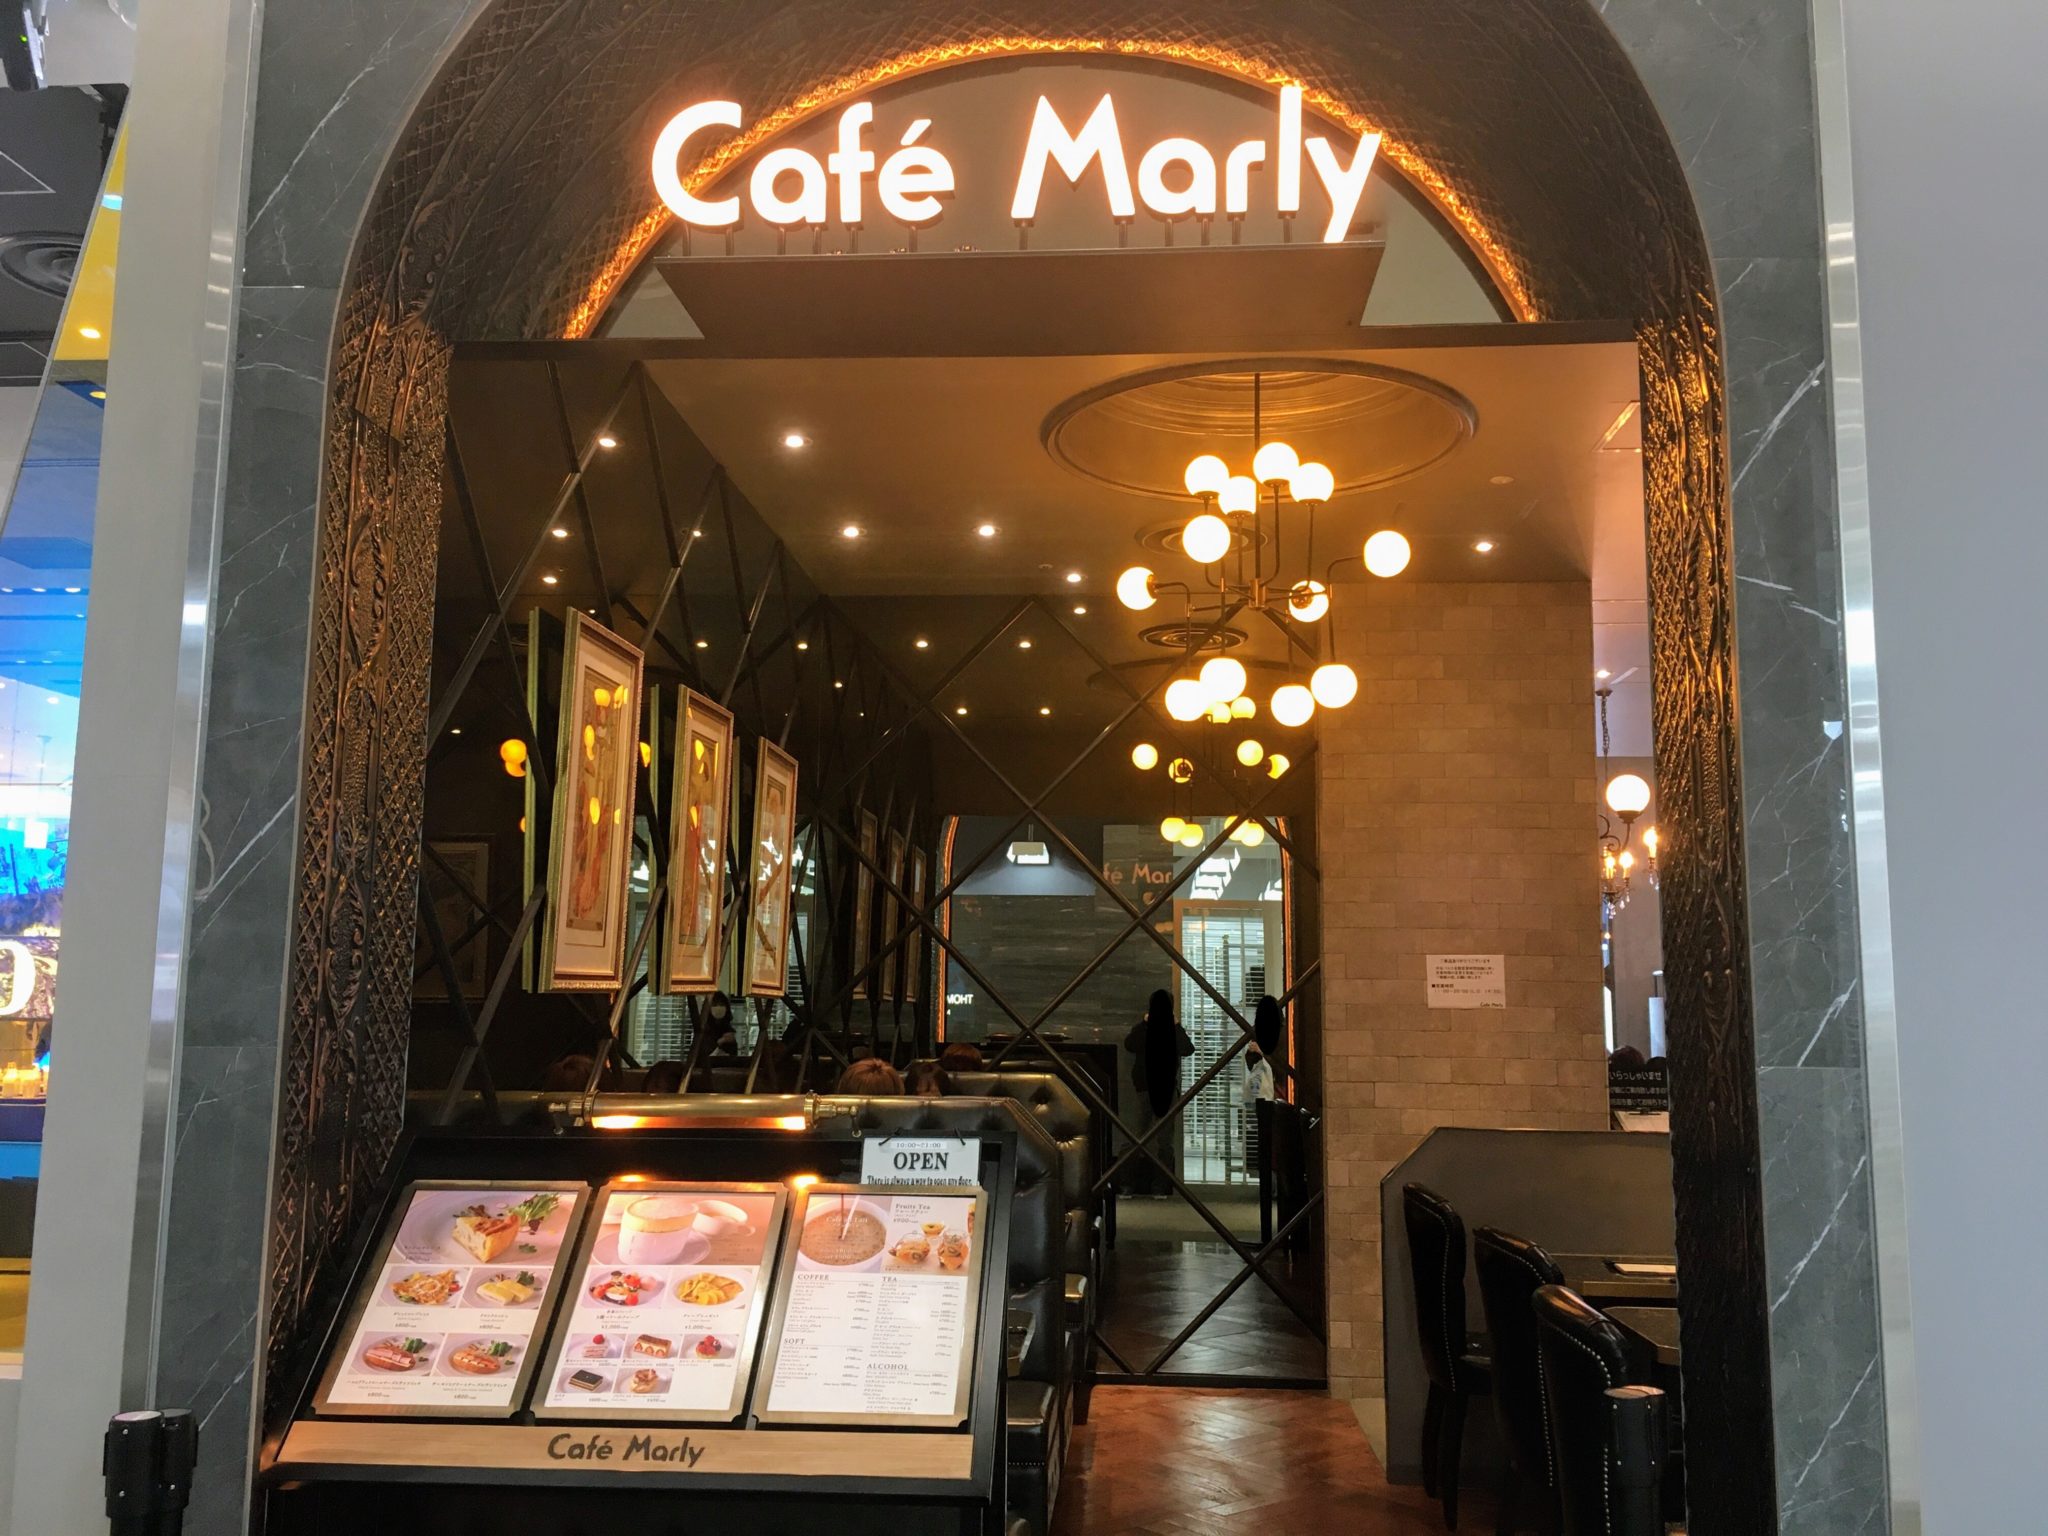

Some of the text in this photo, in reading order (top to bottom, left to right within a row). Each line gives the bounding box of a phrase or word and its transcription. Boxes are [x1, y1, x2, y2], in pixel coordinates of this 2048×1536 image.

[652, 85, 1383, 243] Café Marly
[893, 1152, 949, 1170] OPEN
[547, 1433, 705, 1468] Café Marly
